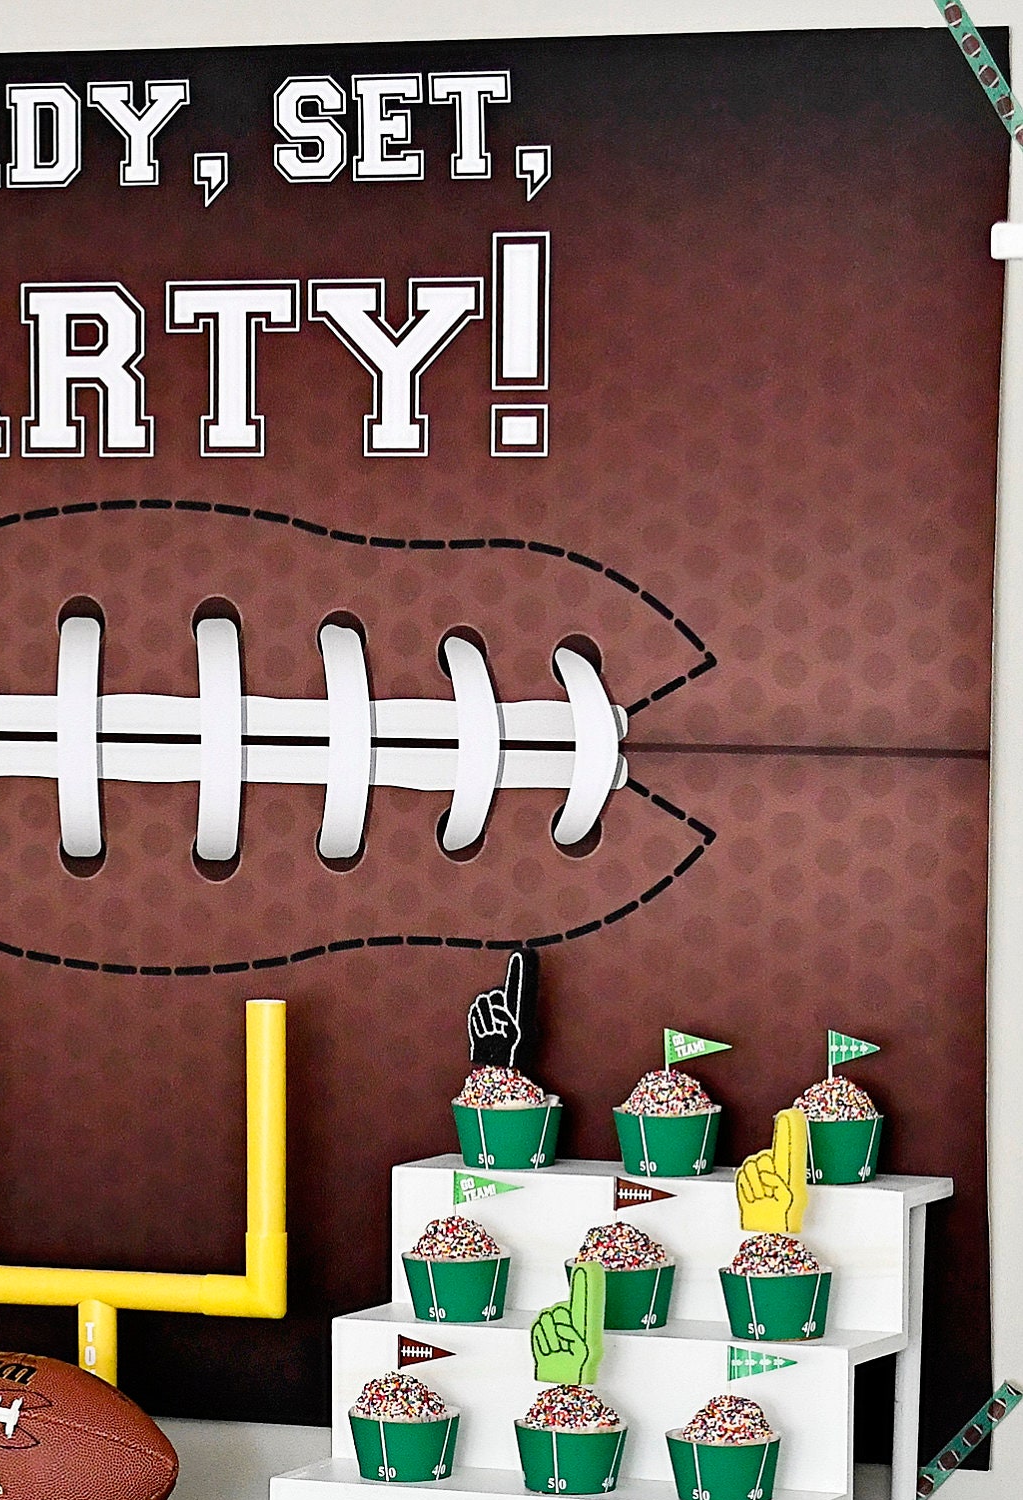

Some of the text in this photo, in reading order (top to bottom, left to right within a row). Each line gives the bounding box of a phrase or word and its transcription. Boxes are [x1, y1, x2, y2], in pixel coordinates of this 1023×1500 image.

[274, 70, 551, 202] SET,
[672, 1034, 685, 1045] GO
[478, 1154, 545, 1165] 50 40
[640, 1159, 707, 1172] 50 40
[858, 1166, 871, 1177] 40
[460, 1178, 475, 1190] GO
[429, 1305, 496, 1318] 50 40
[641, 1314, 657, 1324] 40
[748, 1322, 816, 1334] 50 40
[378, 1465, 445, 1478] 50 40
[548, 1477, 614, 1489] 50 40
[692, 1489, 763, 1500] 50 40
